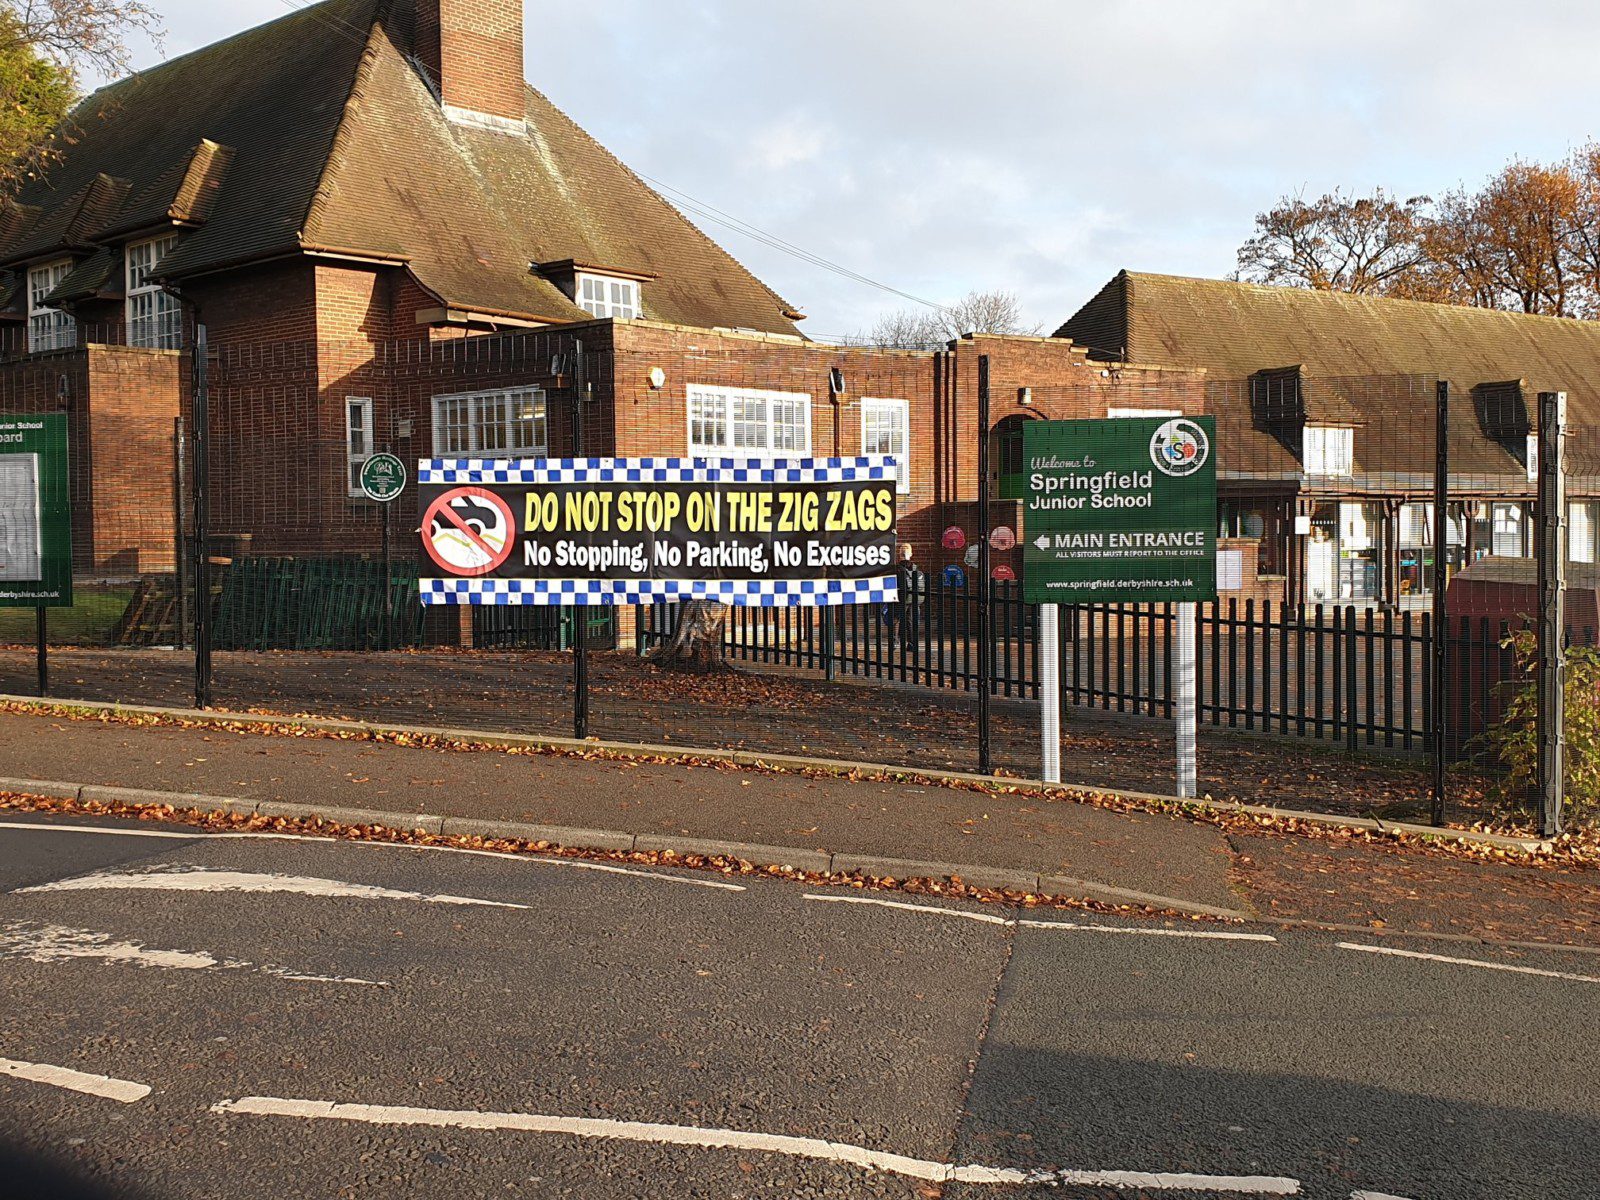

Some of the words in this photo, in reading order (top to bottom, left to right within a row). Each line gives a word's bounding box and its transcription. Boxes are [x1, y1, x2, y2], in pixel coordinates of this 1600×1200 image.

[17, 421, 43, 429] School
[1031, 455, 1081, 470] Welcome
[1083, 455, 1097, 468] to
[1030, 470, 1152, 494] Springfield
[1030, 495, 1086, 509] Junior
[1091, 492, 1152, 508] School
[524, 492, 559, 532] DO
[565, 491, 613, 532] NOT
[617, 491, 680, 532] STOP
[686, 491, 720, 532] ON
[726, 492, 773, 532] THE
[777, 491, 819, 532] ZIG
[825, 489, 892, 531] ZAGS
[1055, 533, 1103, 548] MAIN
[1109, 531, 1205, 547] ENTRANCE
[524, 540, 551, 566] No
[555, 539, 648, 572] Stopping,
[654, 540, 681, 567] No
[686, 540, 768, 573] Parking,
[774, 540, 802, 567] No
[807, 540, 891, 566] Excuses
[1046, 579, 1194, 590] www.springfield.derbyshire.sch.uk
